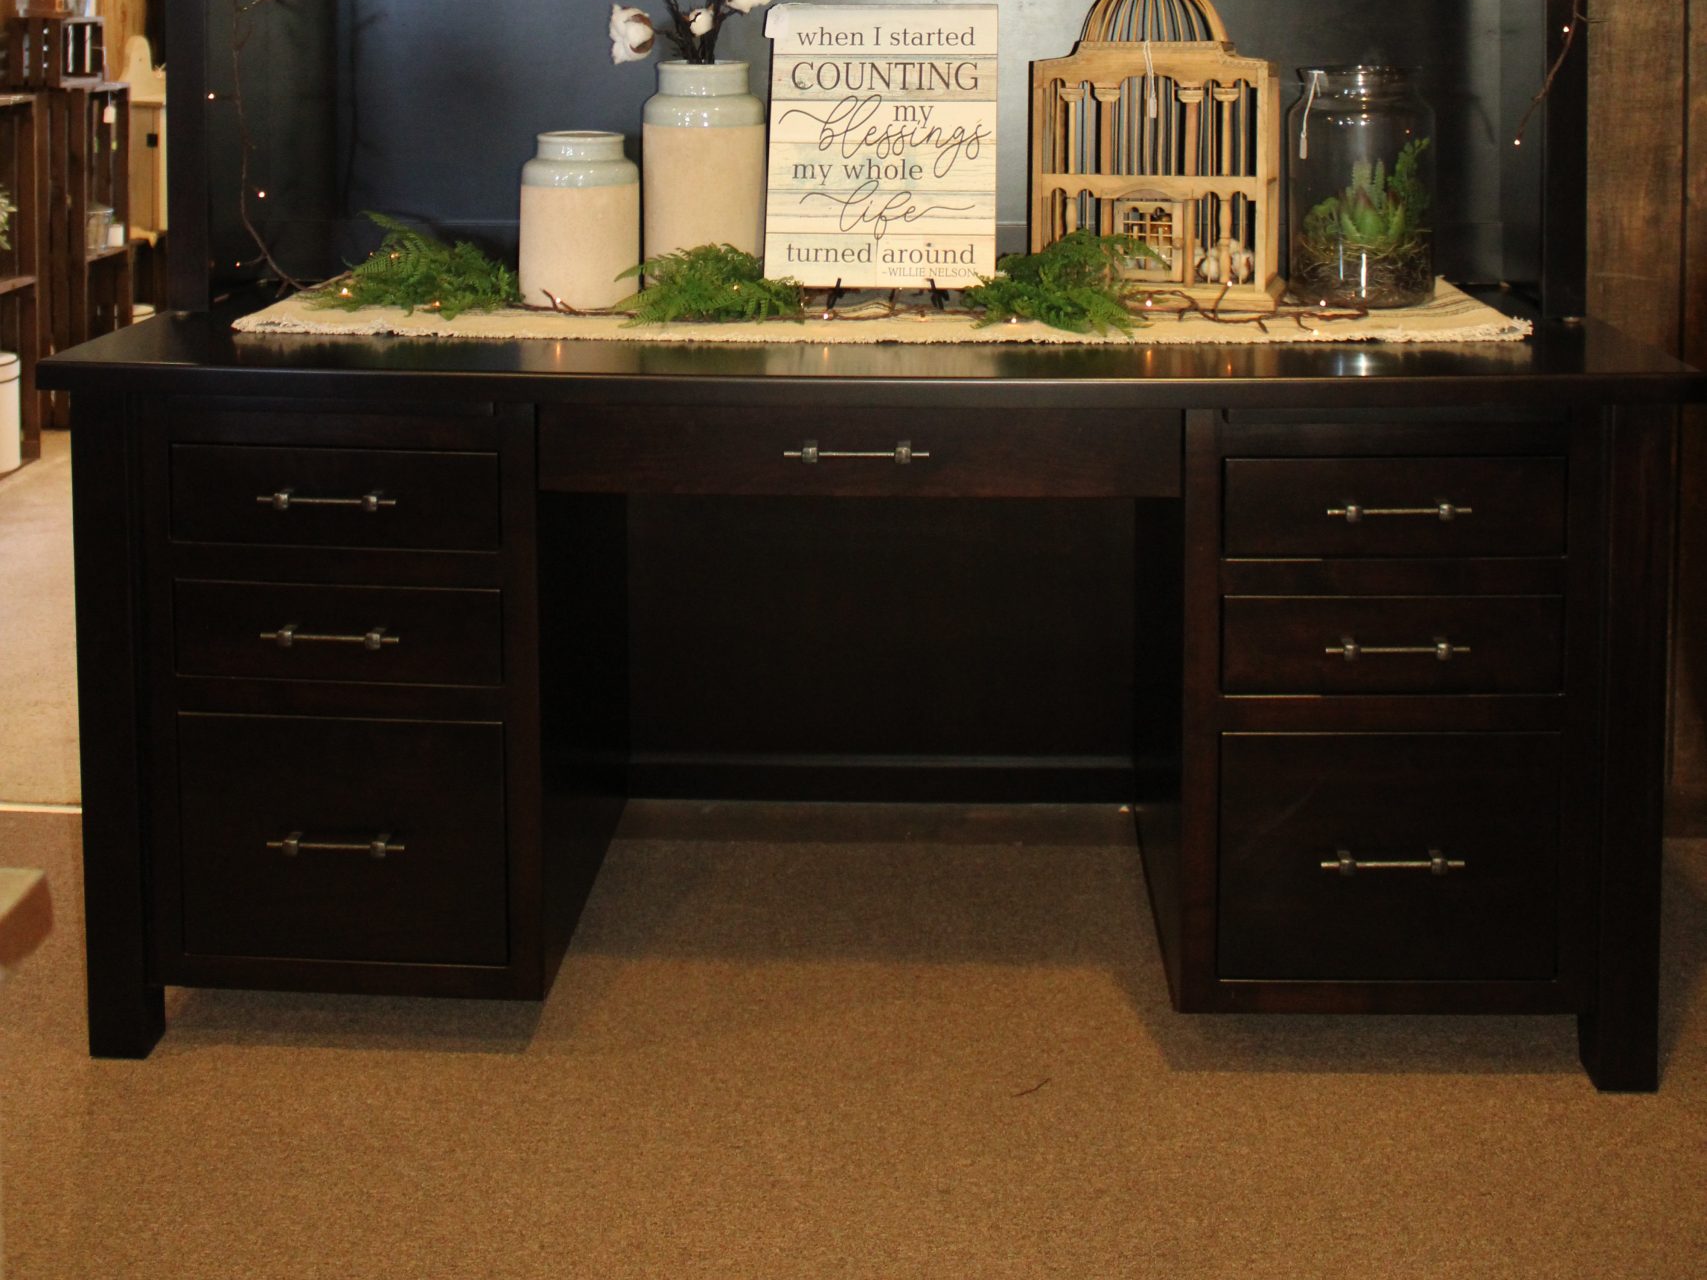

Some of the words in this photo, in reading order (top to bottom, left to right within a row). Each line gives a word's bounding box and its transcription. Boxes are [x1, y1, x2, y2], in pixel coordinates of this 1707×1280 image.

[798, 26, 864, 47] when
[873, 27, 882, 46] I
[890, 26, 976, 46] started
[791, 62, 979, 90] COUNTING
[893, 105, 934, 129] my
[779, 94, 992, 178] blessings
[792, 163, 833, 185] my
[843, 160, 923, 180] whole
[800, 180, 976, 240] life
[787, 243, 872, 263] turned
[882, 244, 975, 264] around
[929, 268, 976, 277] NELSON
